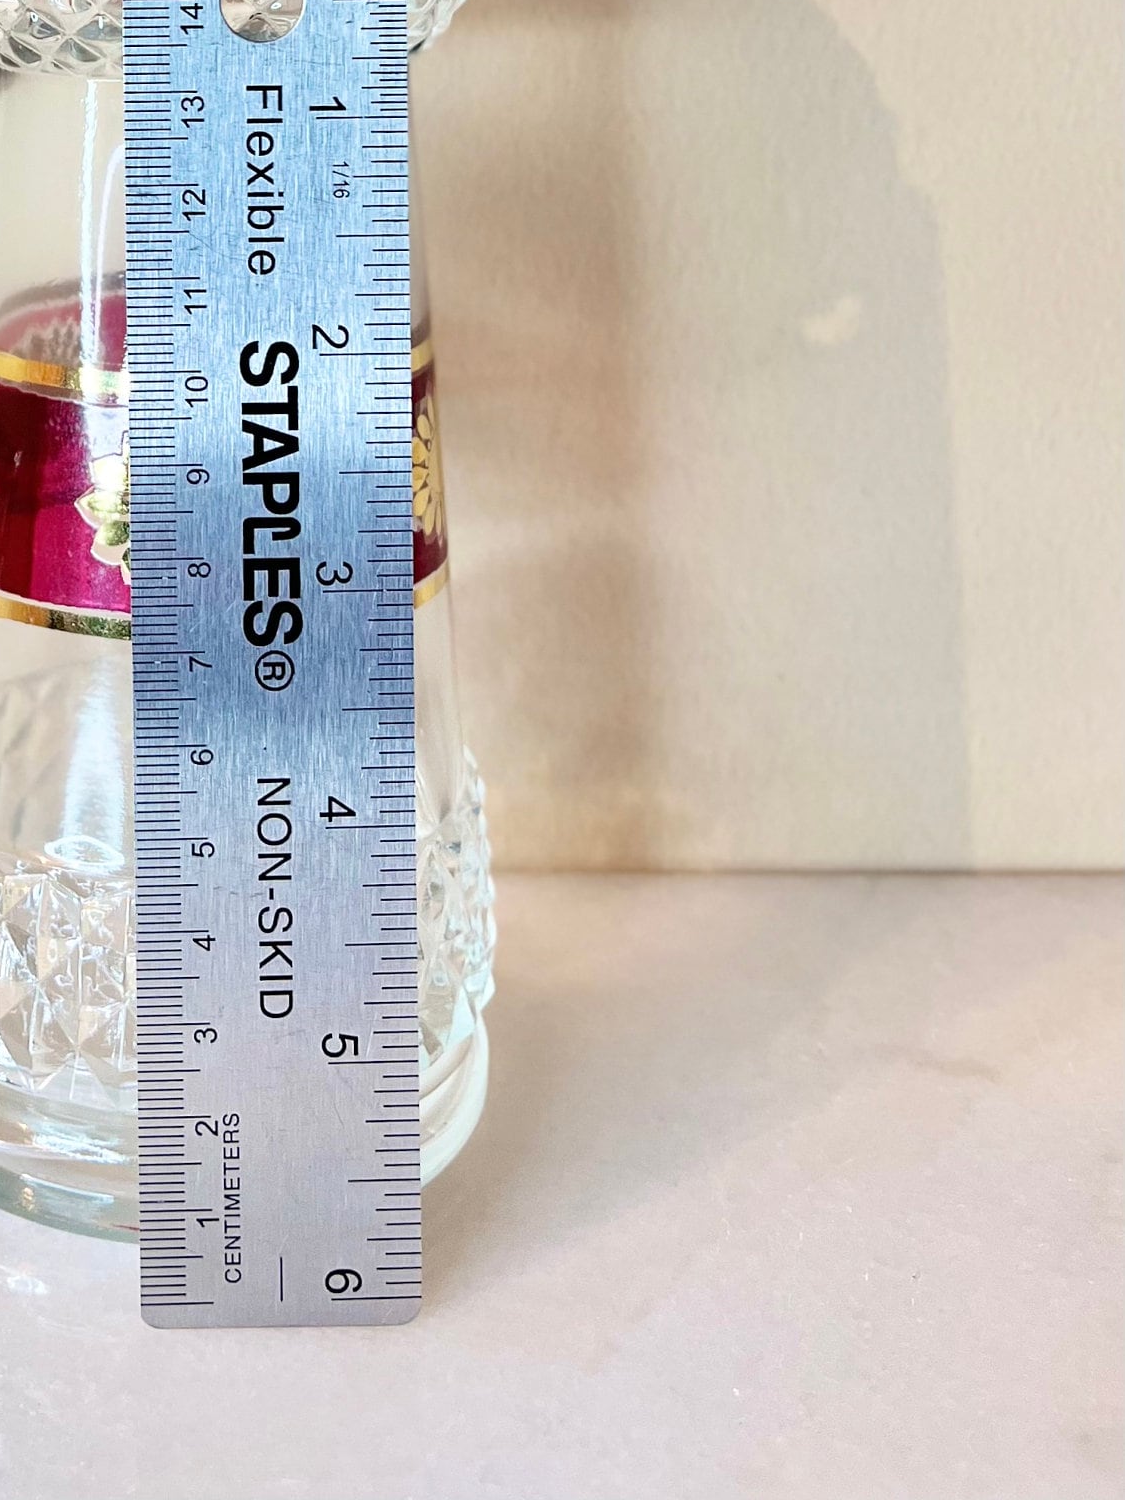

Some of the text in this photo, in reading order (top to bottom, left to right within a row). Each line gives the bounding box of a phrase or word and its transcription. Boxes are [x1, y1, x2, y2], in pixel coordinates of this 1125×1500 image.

[180, 2, 204, 34] 14
[181, 95, 205, 128] 13
[246, 85, 285, 276] Flexible
[332, 161, 350, 199] 1/16
[182, 189, 207, 221] 12
[184, 288, 208, 314] 11
[184, 375, 209, 407] 10
[186, 468, 210, 485] 9
[187, 561, 212, 578] 8
[189, 656, 213, 672] 7
[309, 96, 362, 1294] 1 2 3 4 5 6
[190, 749, 214, 766] 6
[191, 840, 215, 857] 5
[256, 777, 294, 1020] NON-SKID
[192, 934, 217, 952] 4
[194, 1027, 218, 1044] 3
[195, 1120, 219, 1137] 2
[222, 1112, 242, 1284] CENTIMETERS
[196, 1217, 220, 1227] 1
